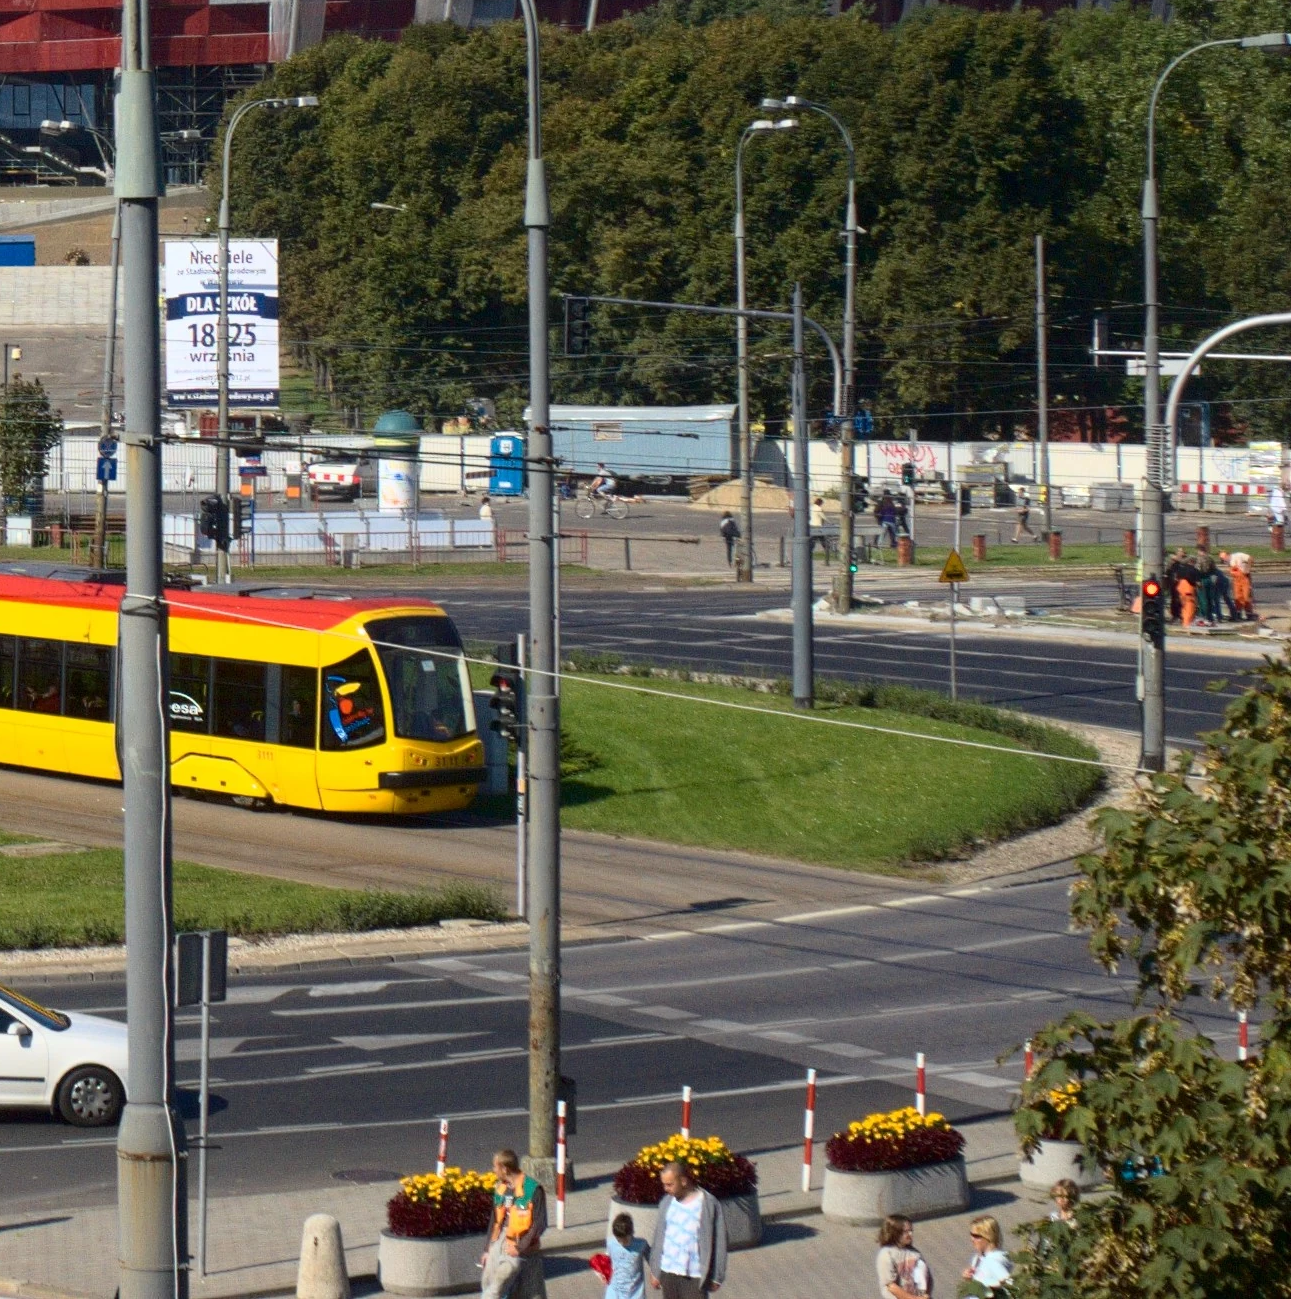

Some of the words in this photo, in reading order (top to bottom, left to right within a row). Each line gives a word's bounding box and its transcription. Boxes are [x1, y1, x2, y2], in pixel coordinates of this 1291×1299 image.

[190, 250, 254, 265] Nieiele
[229, 268, 267, 276] arodowym
[186, 296, 214, 312] DLA
[187, 323, 215, 347] 18
[227, 323, 257, 347] 25
[189, 348, 255, 362] wrzśnia
[170, 703, 199, 716] esa
